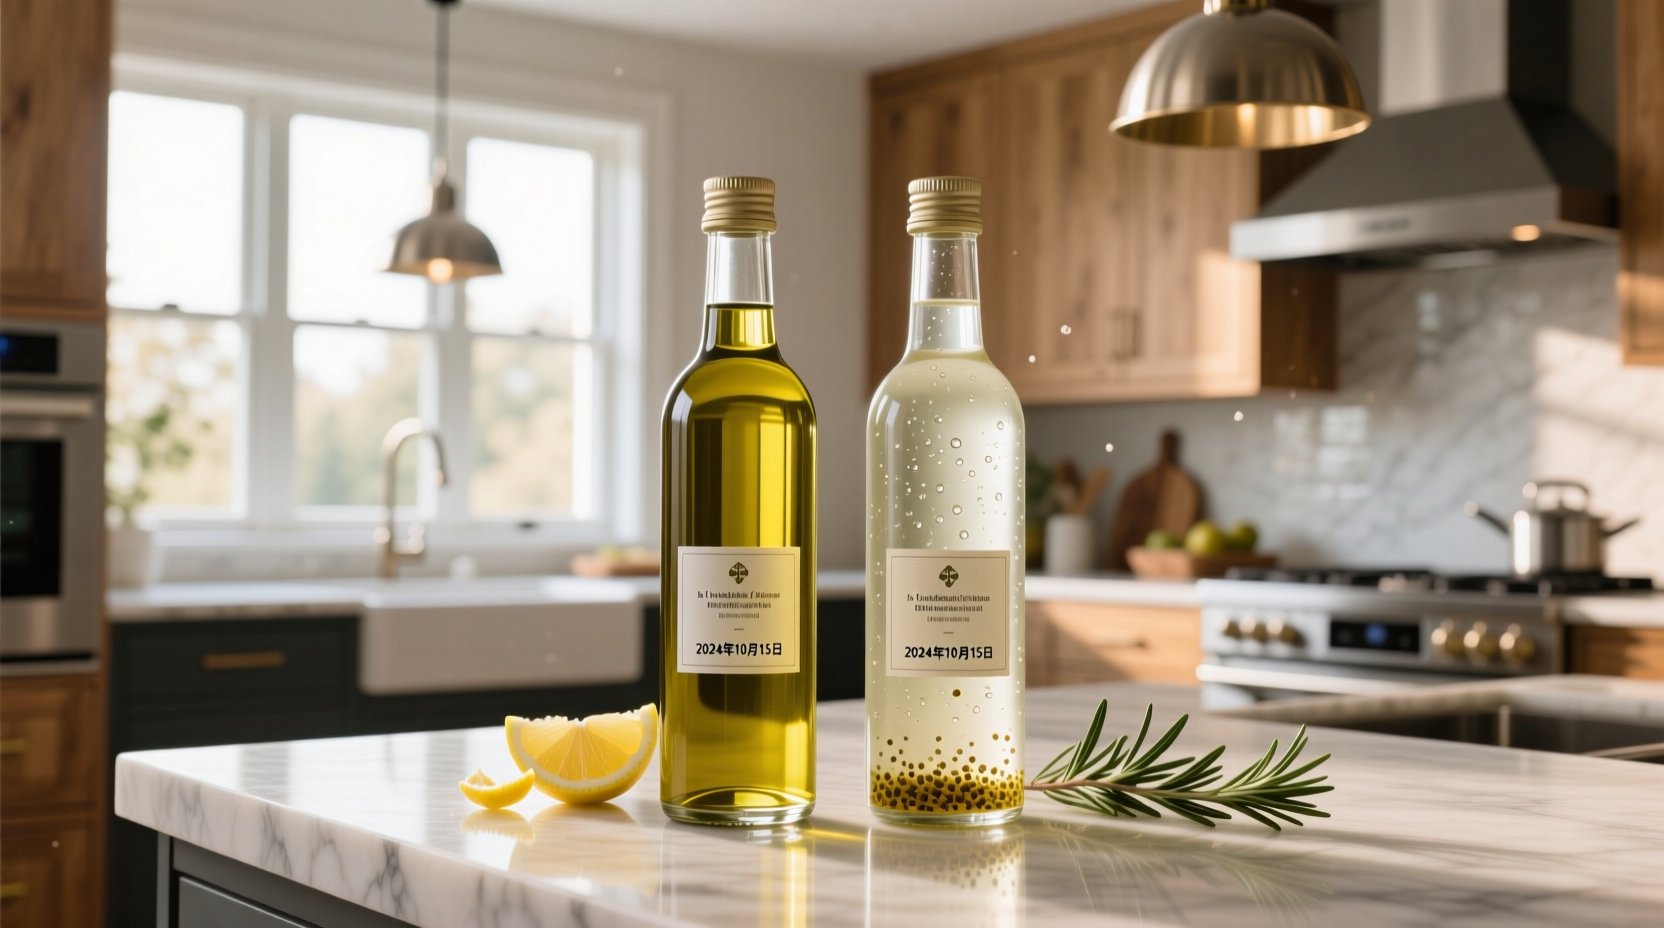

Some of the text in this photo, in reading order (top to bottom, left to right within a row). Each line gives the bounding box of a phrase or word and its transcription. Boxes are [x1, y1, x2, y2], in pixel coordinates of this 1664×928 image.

[696, 642, 782, 657] 2024年10月15日
[904, 645, 993, 661] 2024年10月15日
